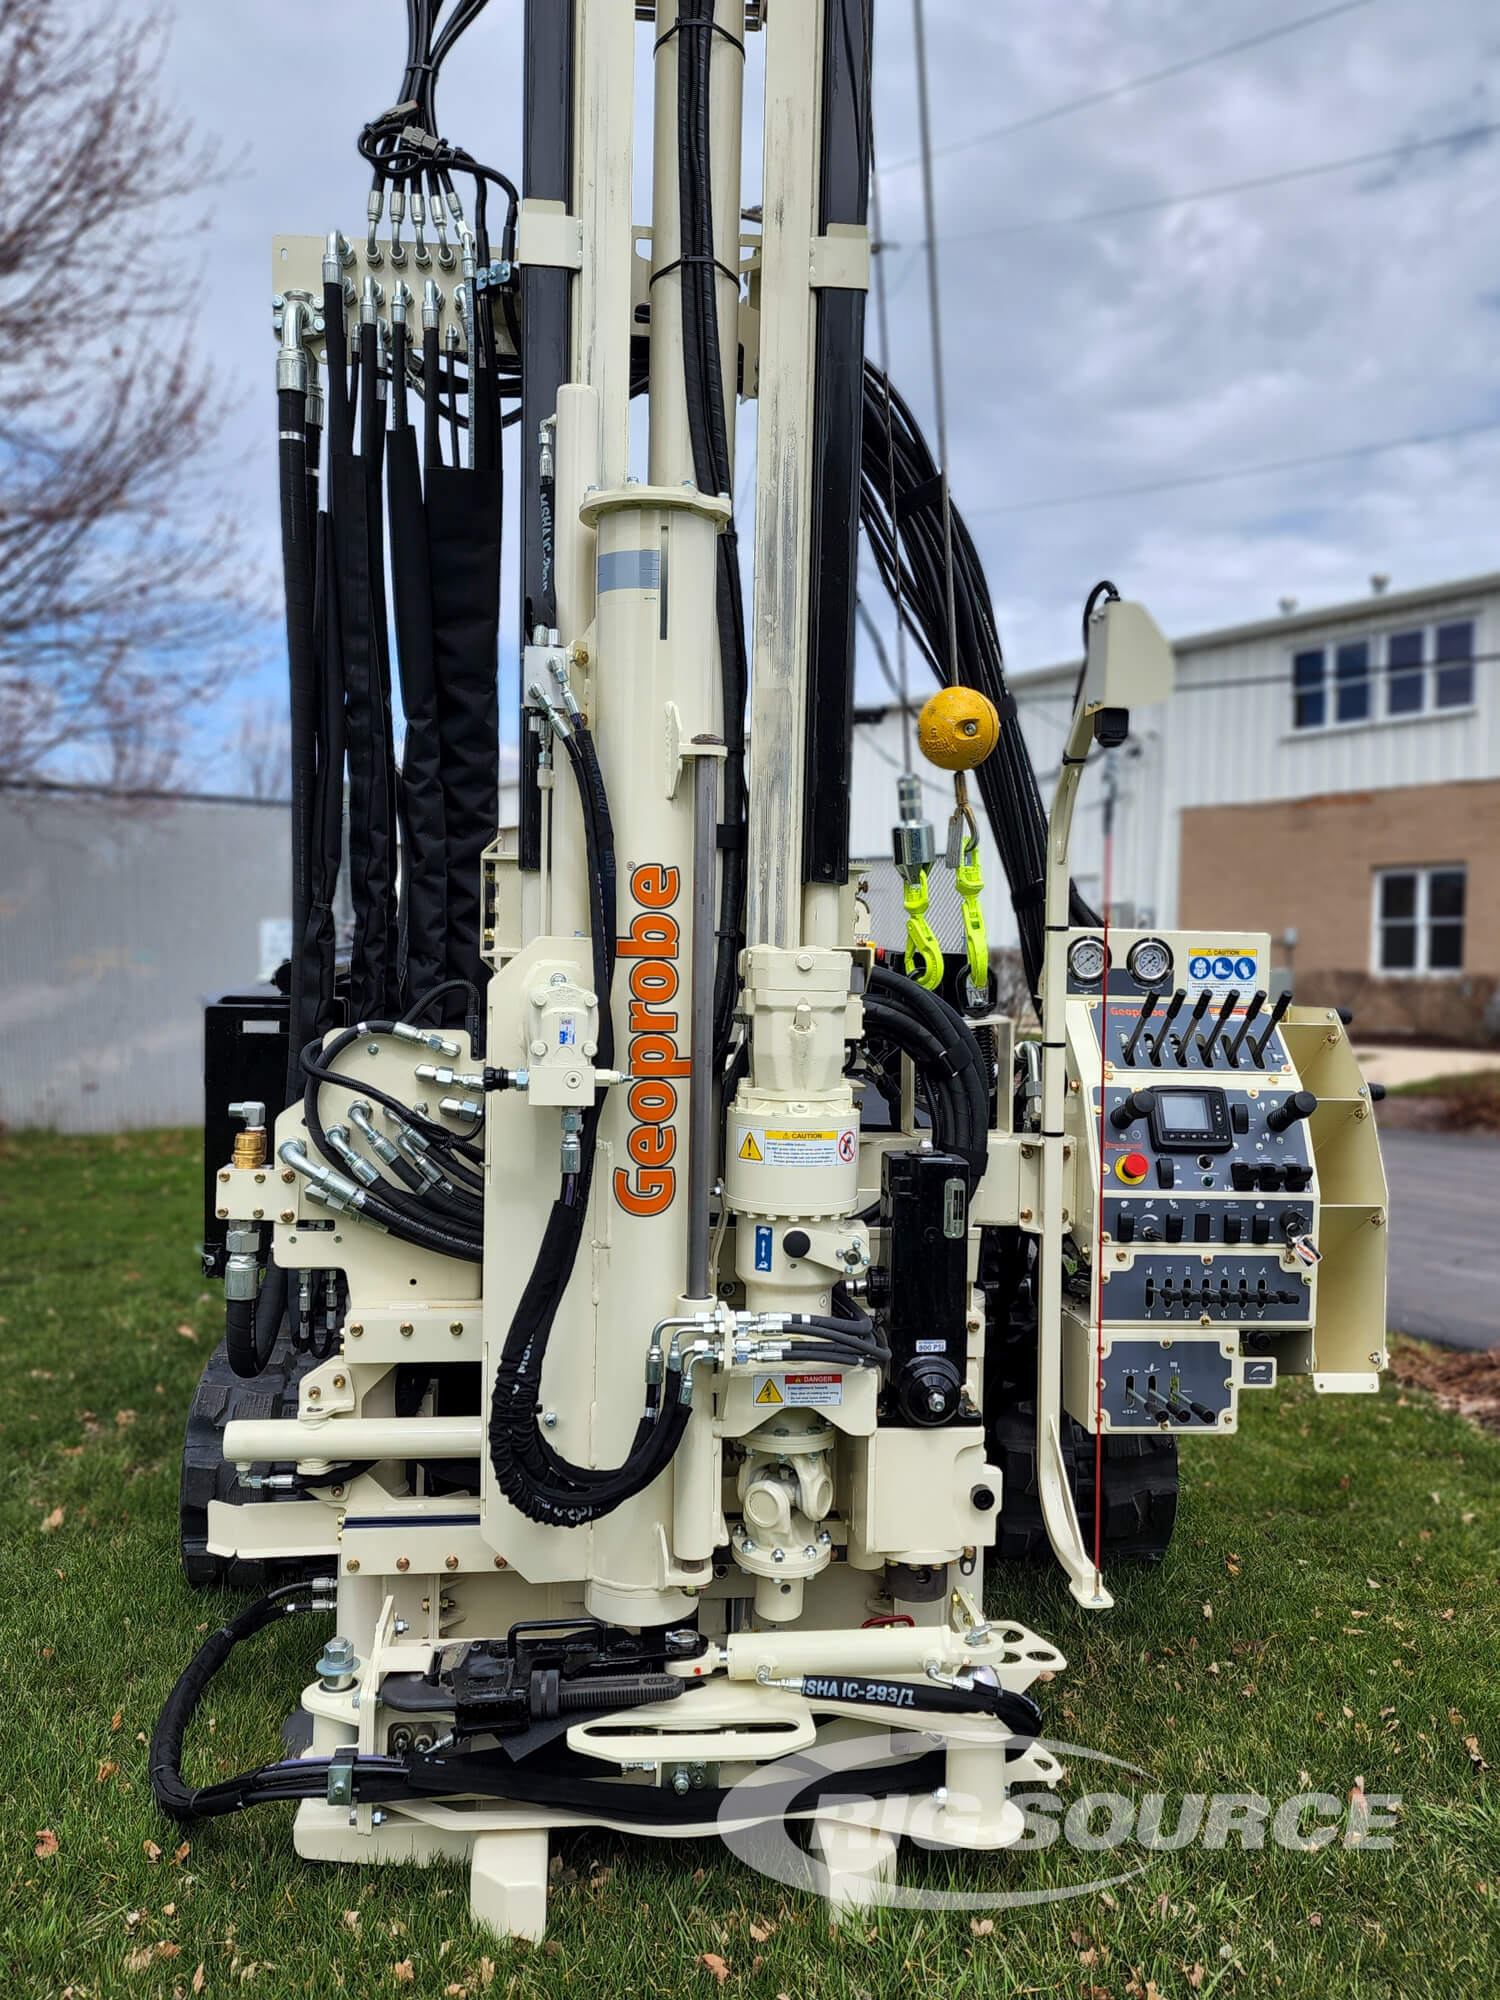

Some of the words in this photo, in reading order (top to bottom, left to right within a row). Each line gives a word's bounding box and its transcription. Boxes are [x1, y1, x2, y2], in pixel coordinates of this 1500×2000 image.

[613, 863, 692, 1218] Geoprobe
[803, 1375, 833, 1383] DANGER
[842, 1682, 916, 1706] IC-293/1
